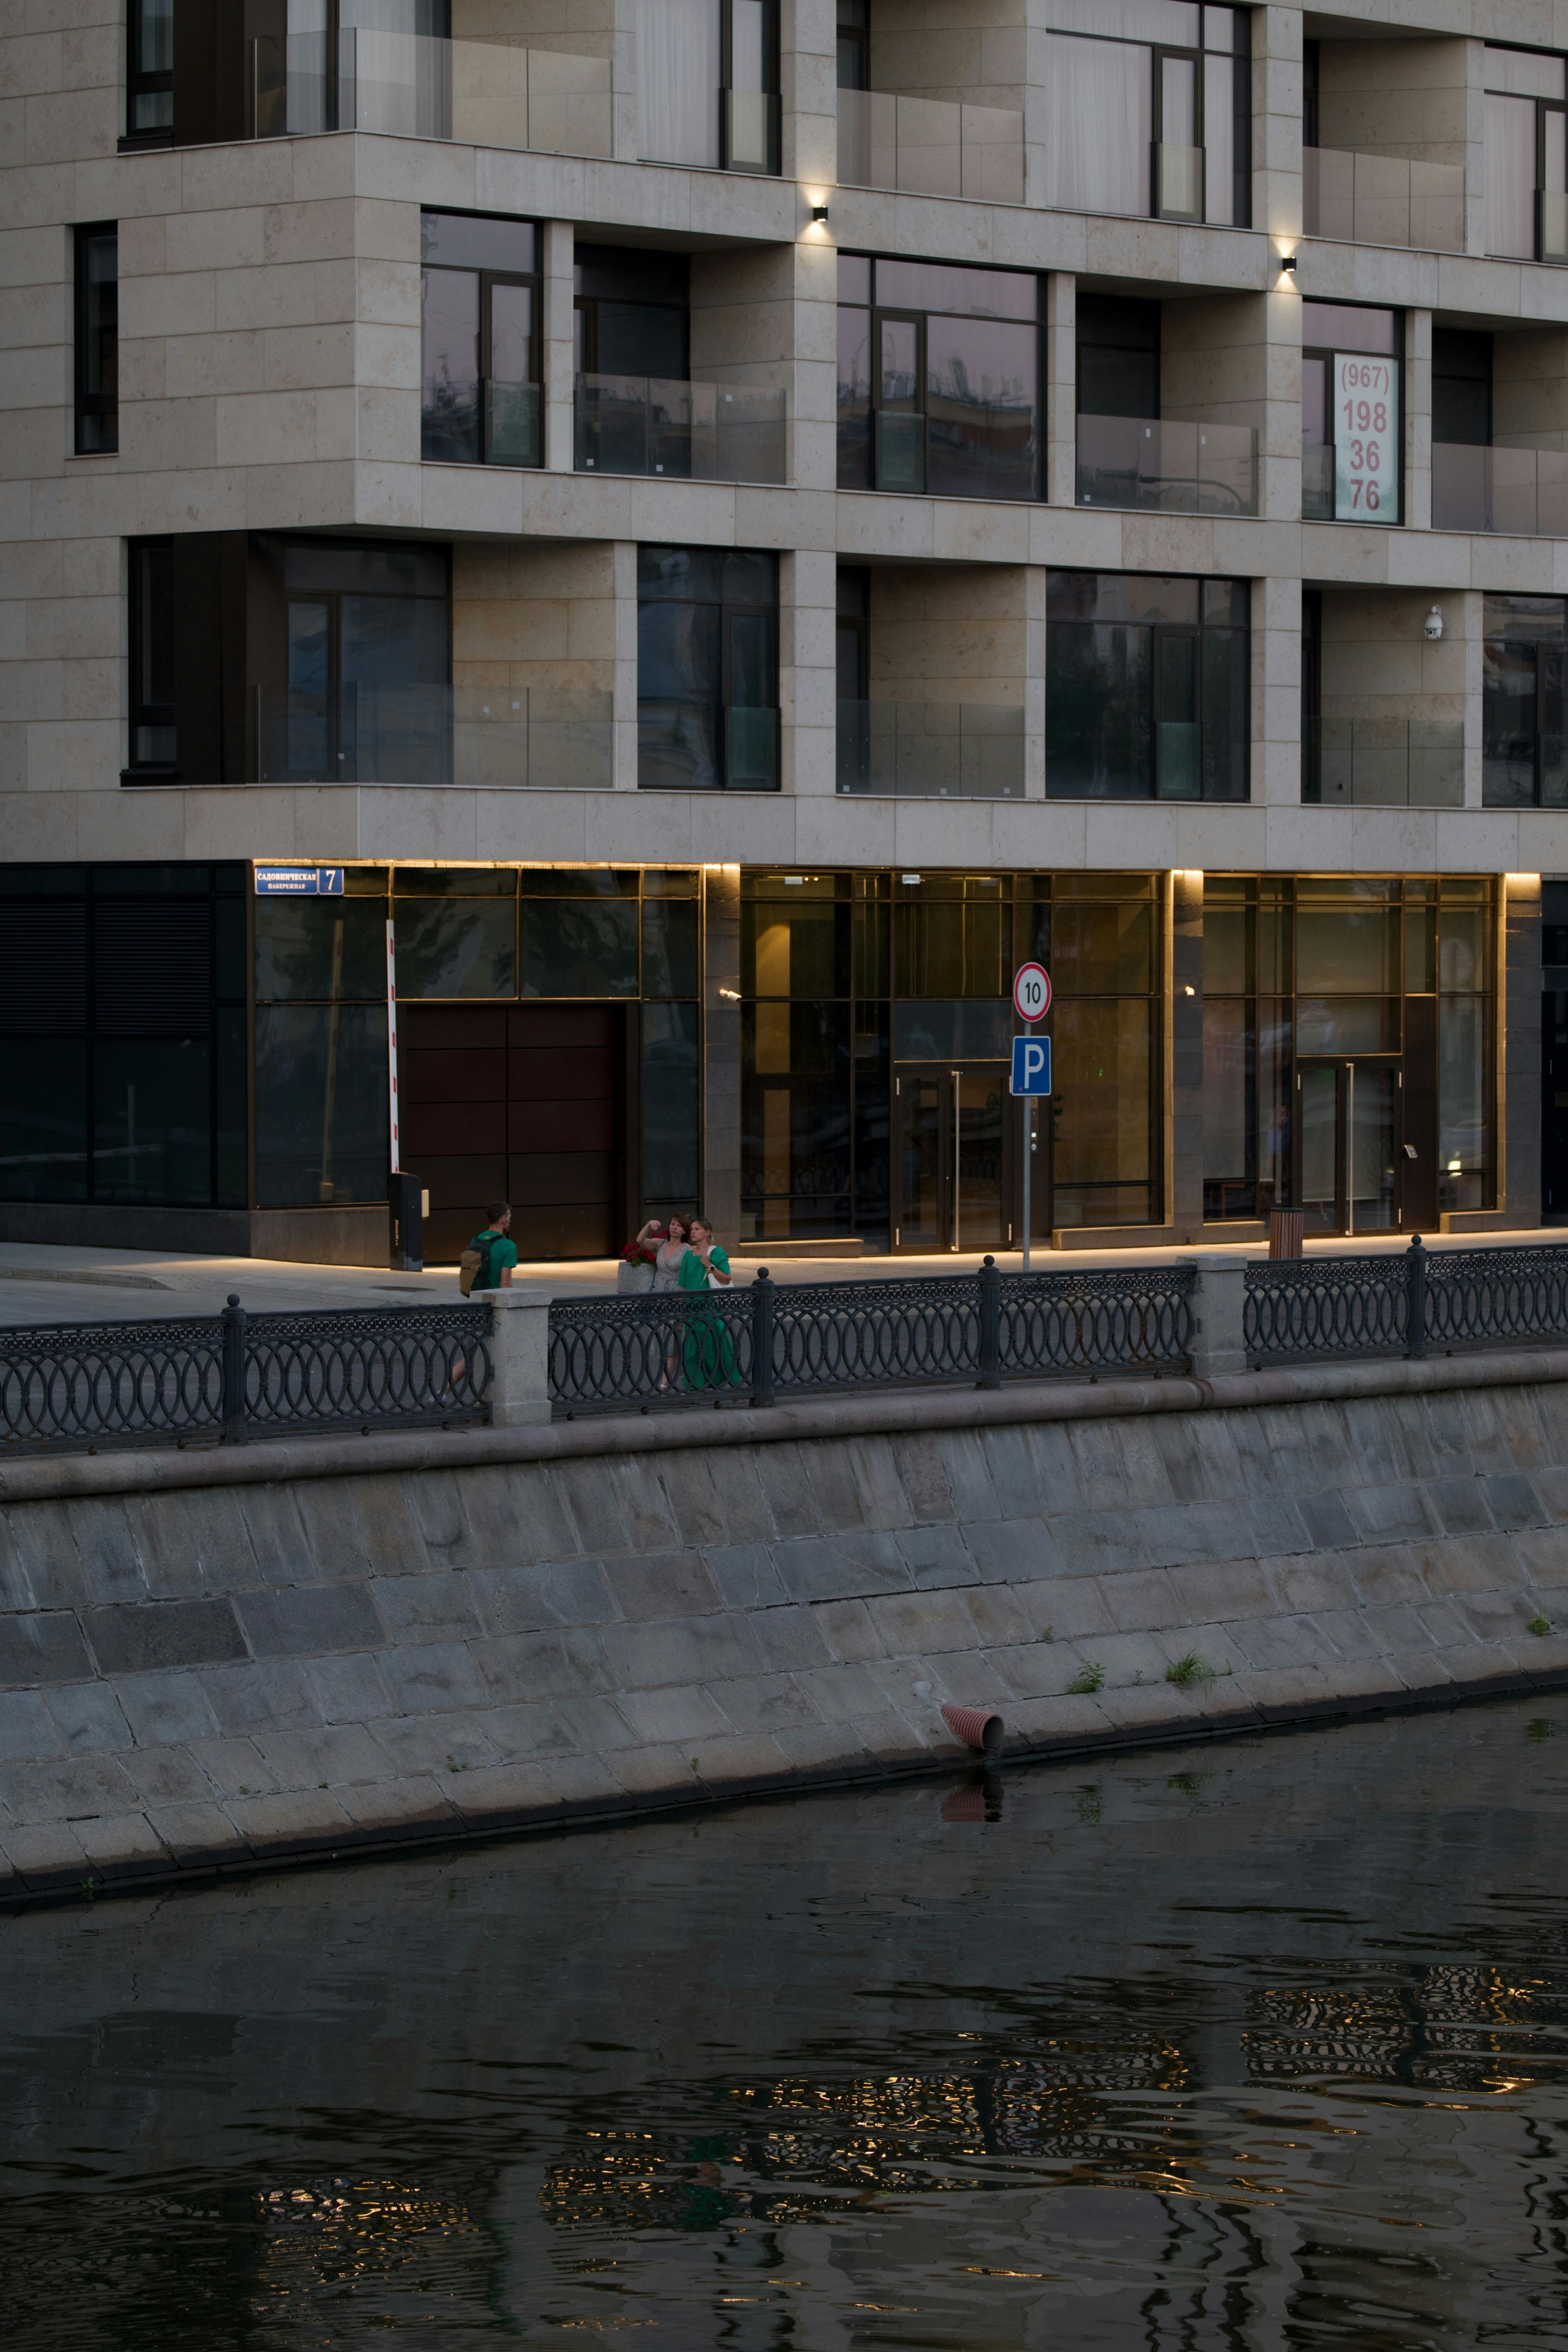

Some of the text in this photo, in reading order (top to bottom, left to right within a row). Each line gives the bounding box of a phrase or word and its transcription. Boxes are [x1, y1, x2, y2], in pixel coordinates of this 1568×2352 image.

[1341, 363, 1389, 396] (967)
[1343, 399, 1387, 433] 198
[1350, 439, 1379, 472] 36
[1350, 479, 1379, 511] 76
[326, 870, 336, 891] 7
[1025, 982, 1041, 1004] 10
[1024, 1044, 1044, 1089] P
